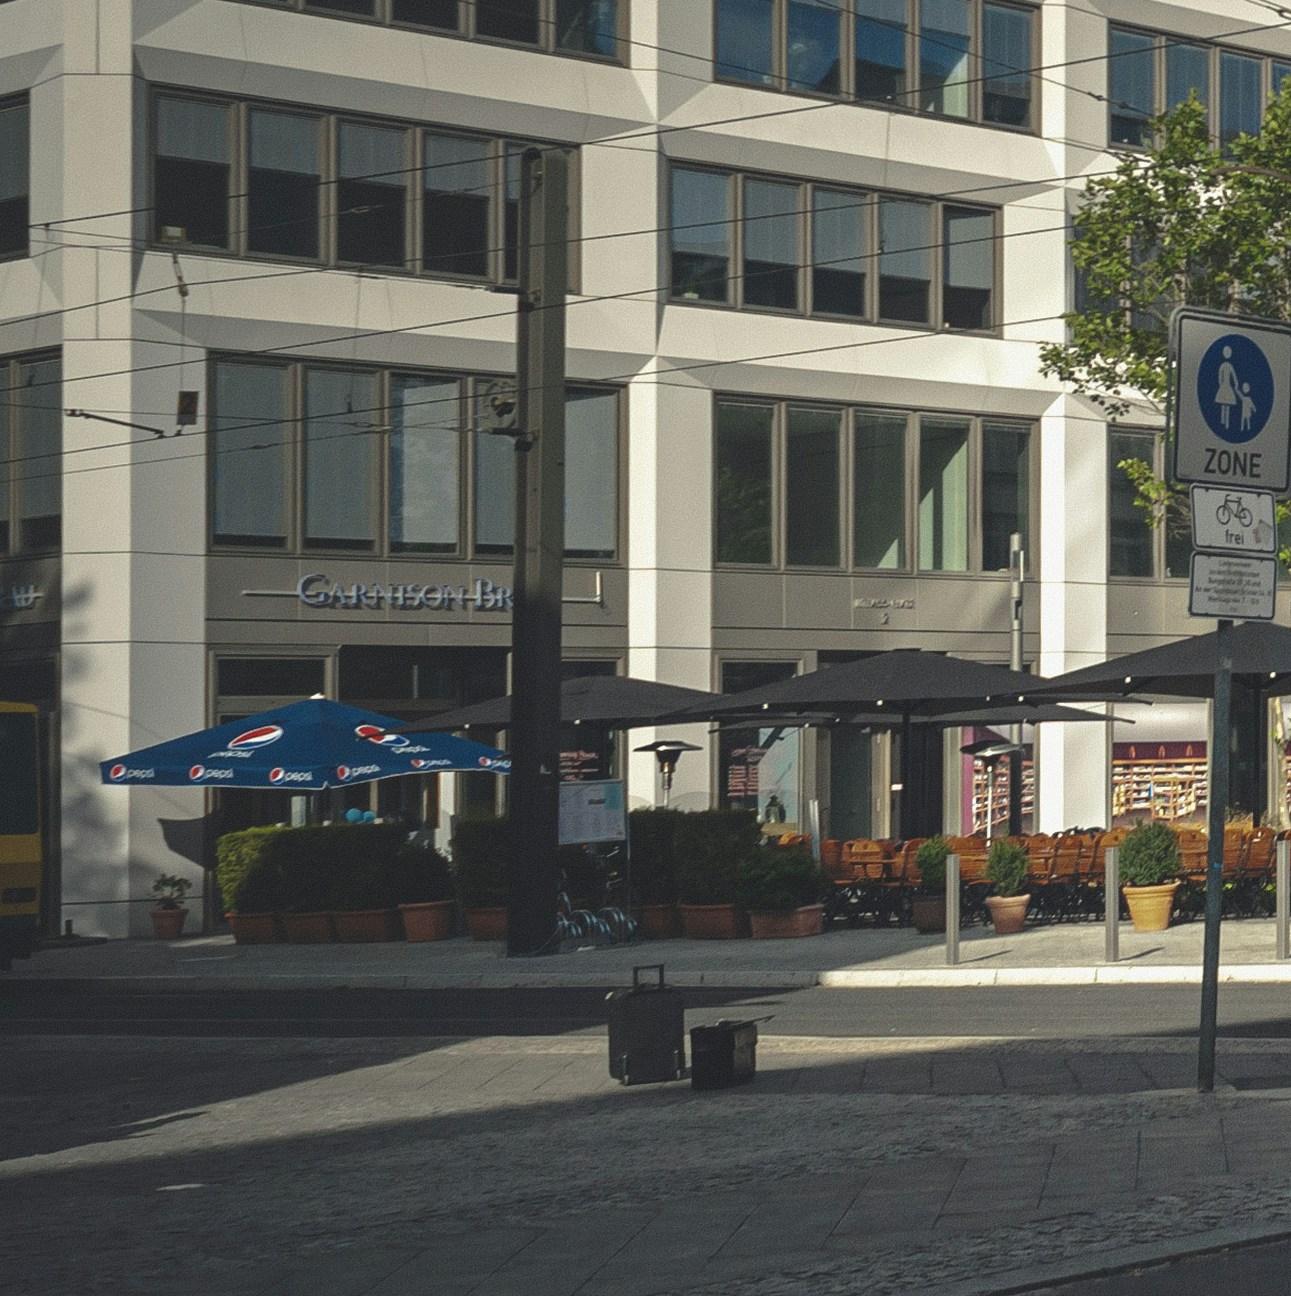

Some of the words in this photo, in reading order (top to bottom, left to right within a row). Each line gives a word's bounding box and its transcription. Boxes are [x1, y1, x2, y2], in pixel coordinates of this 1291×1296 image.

[1204, 449, 1262, 478] ZONE
[1225, 529, 1245, 545] frei
[126, 768, 155, 779] pepsi
[204, 768, 234, 779] pepsi
[284, 771, 313, 782] pepsi
